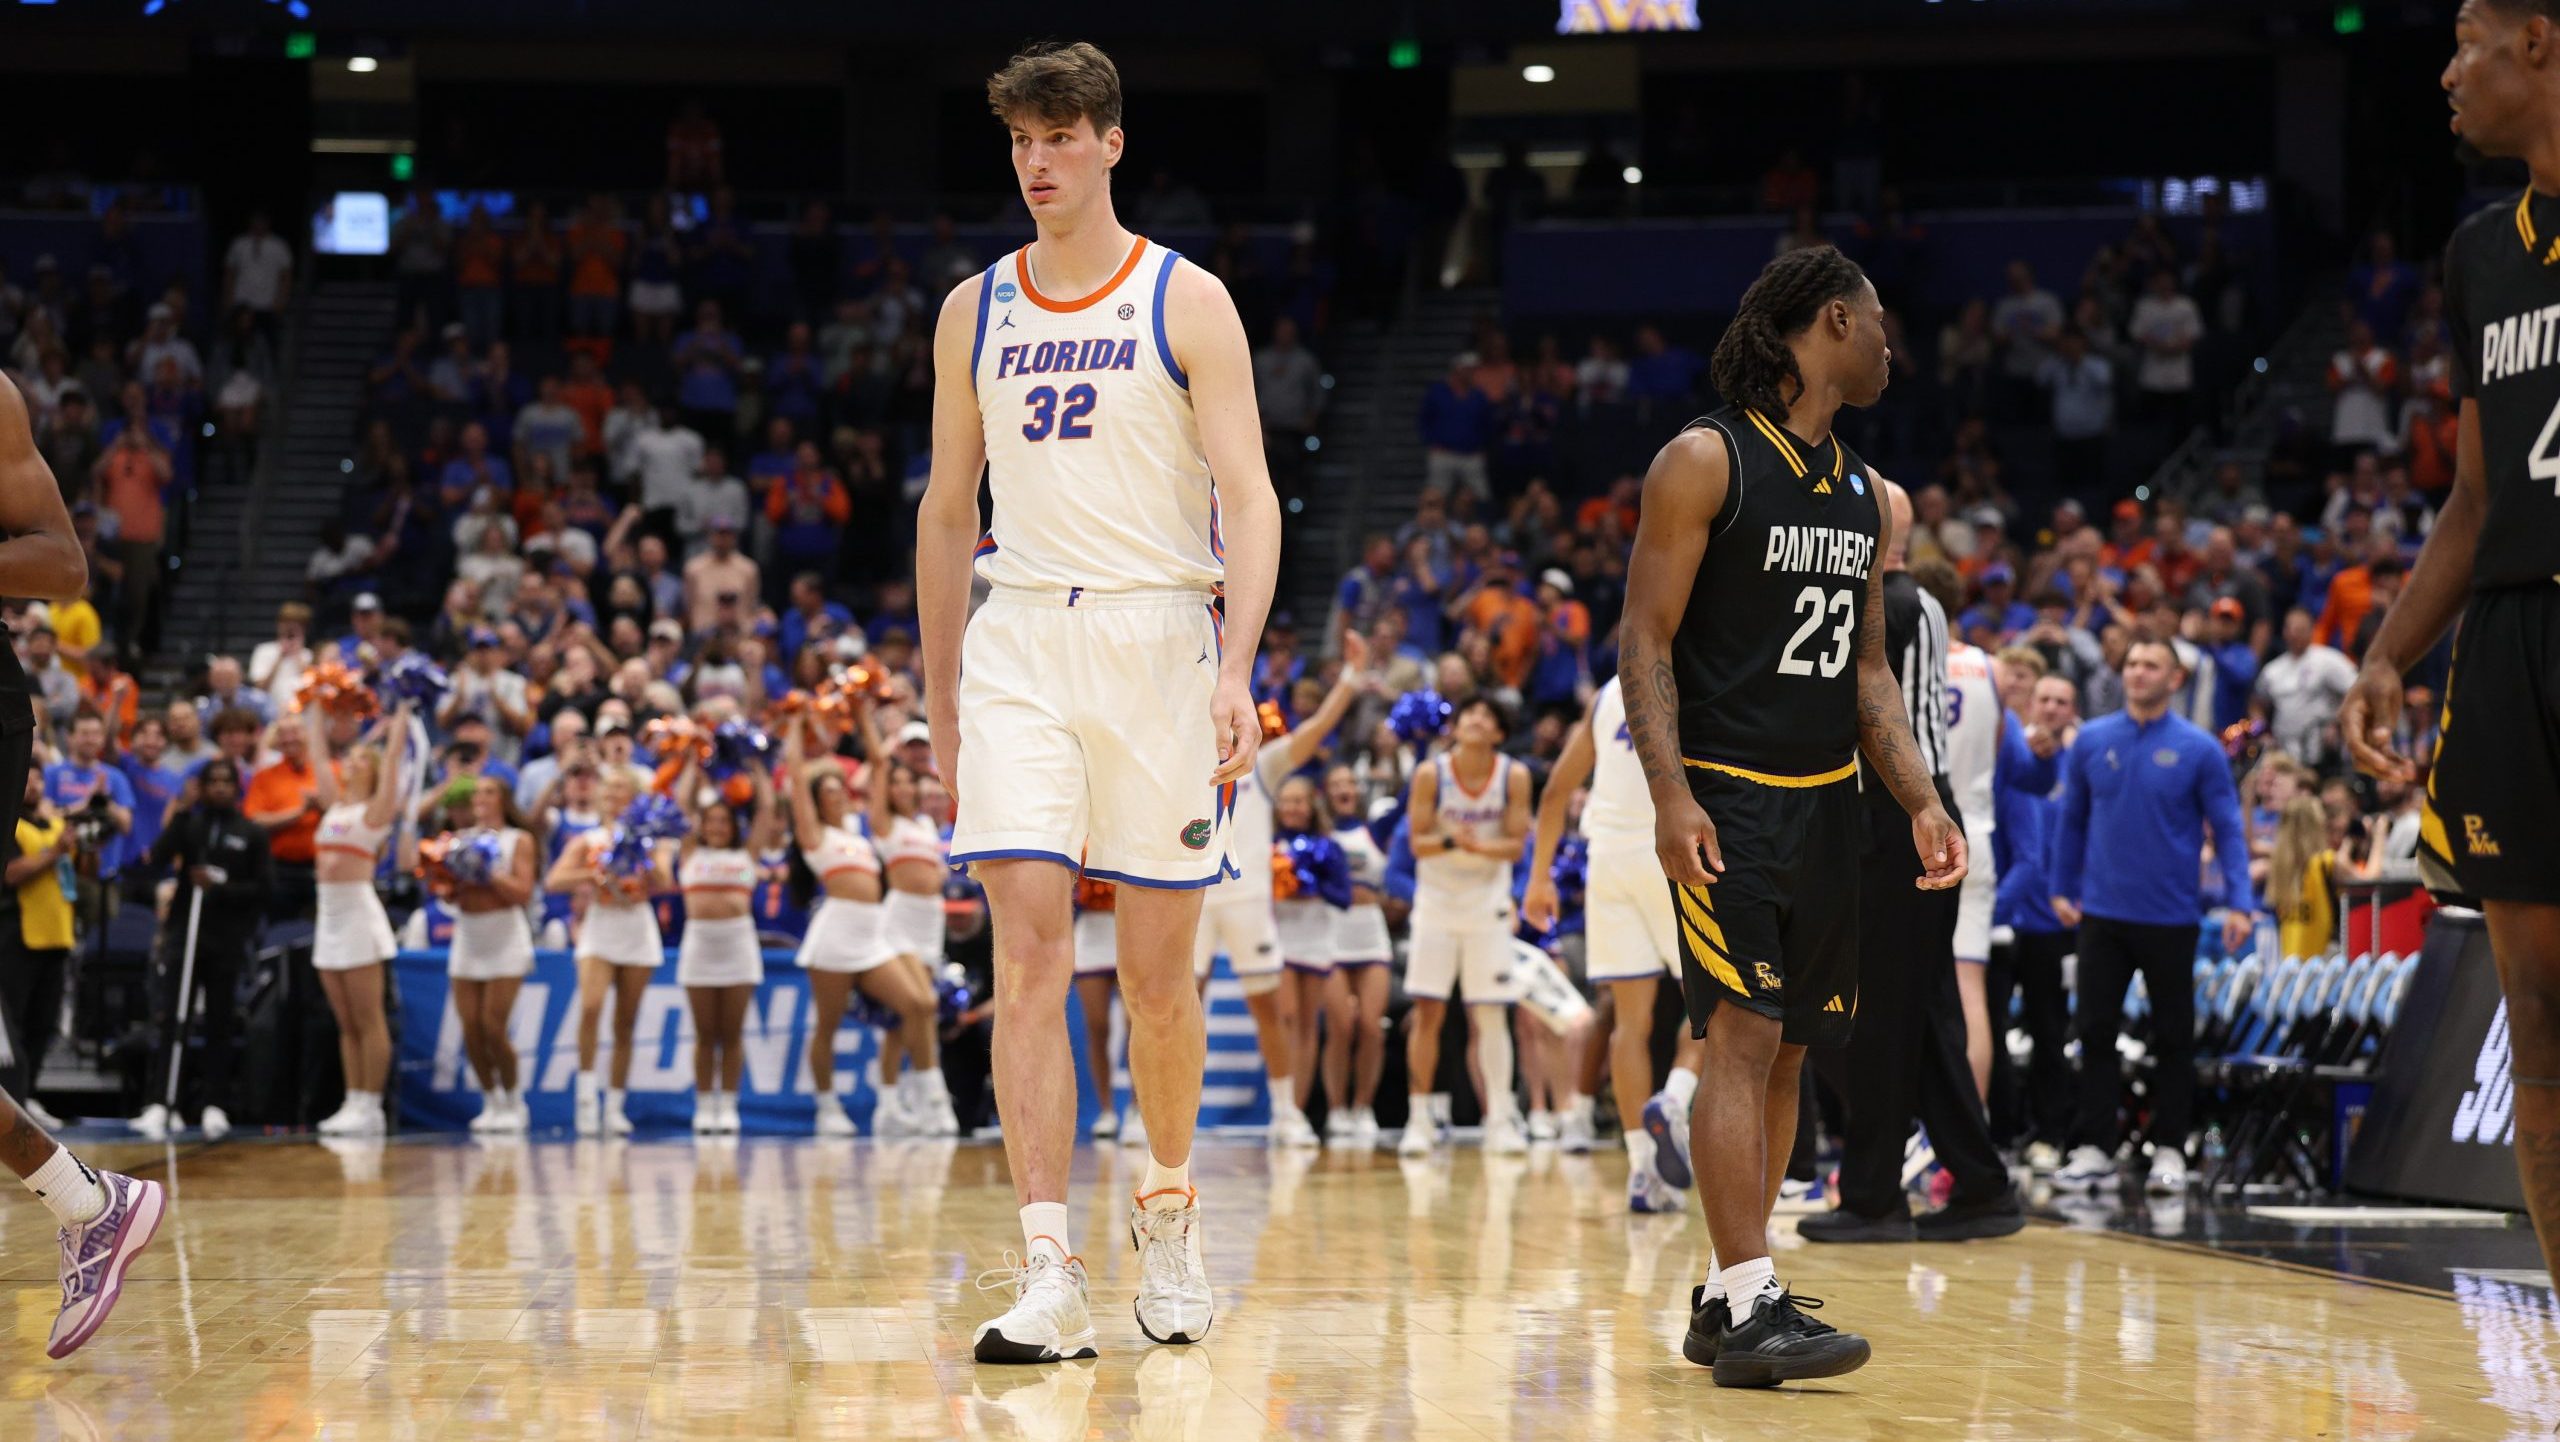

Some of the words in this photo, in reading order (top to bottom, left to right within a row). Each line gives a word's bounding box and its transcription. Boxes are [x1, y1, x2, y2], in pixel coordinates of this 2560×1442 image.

[996, 339, 1137, 380] FLORIDA
[2482, 303, 2560, 385] PANT
[1022, 383, 1098, 442] 32
[1067, 586, 1085, 607] F
[1776, 585, 1855, 678] 23
